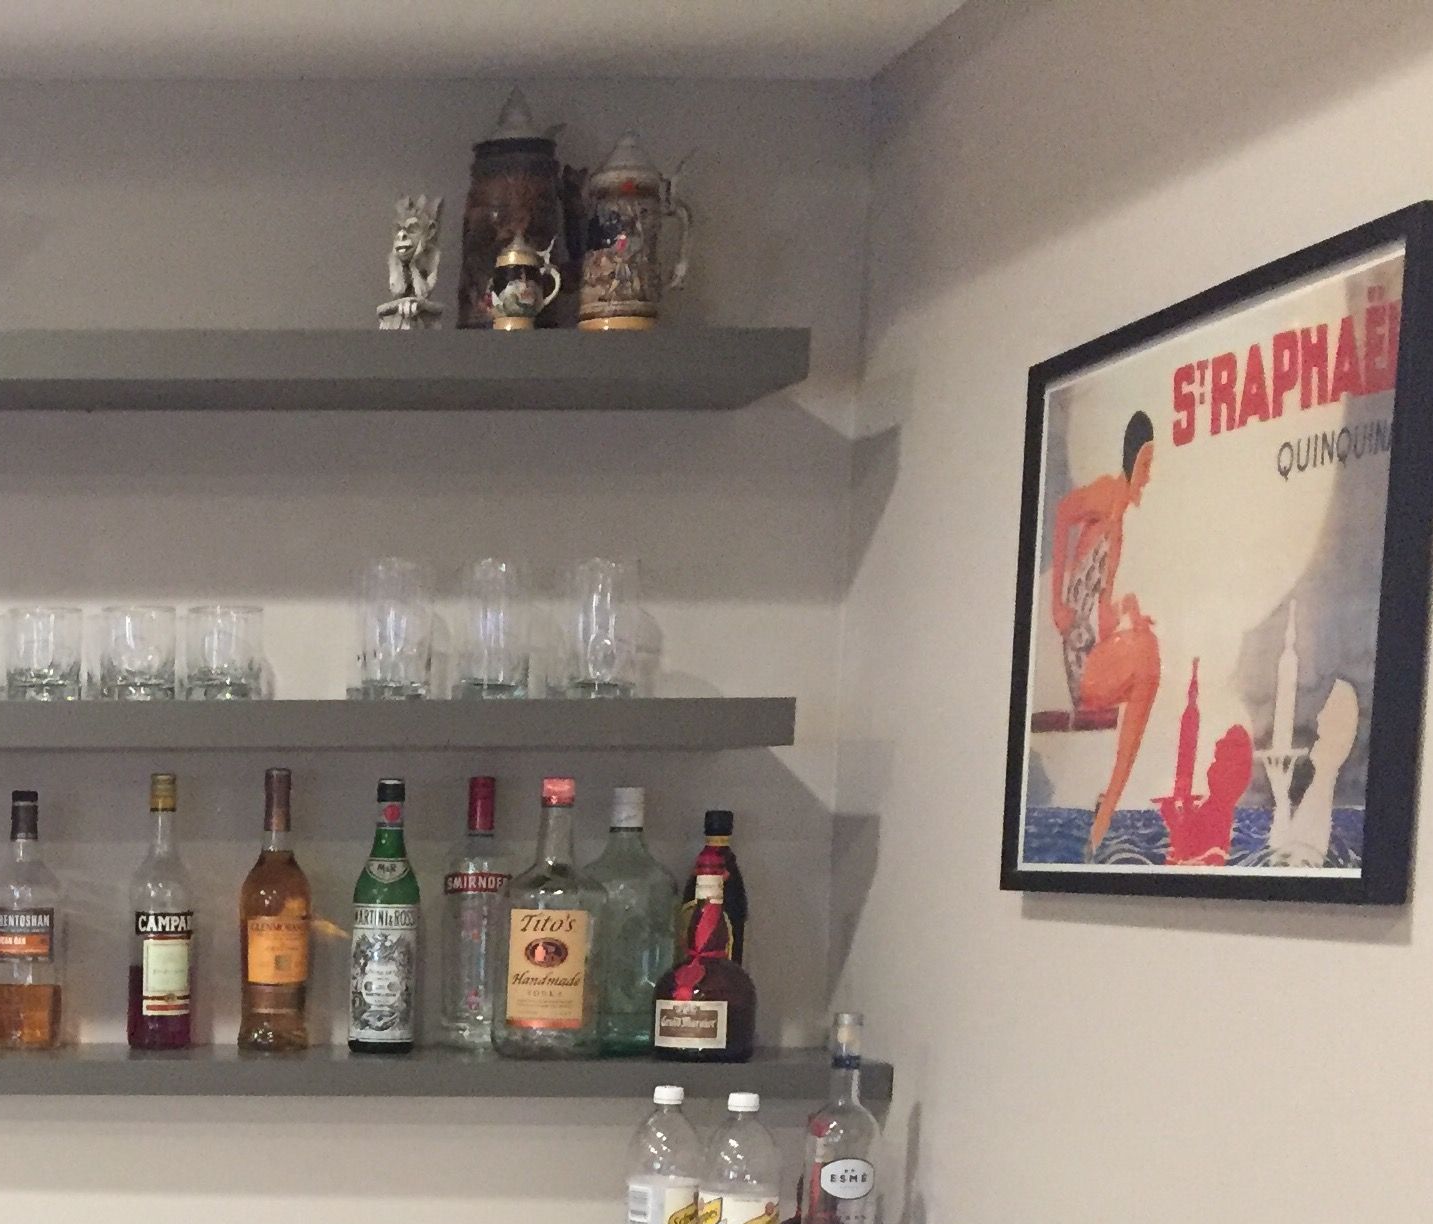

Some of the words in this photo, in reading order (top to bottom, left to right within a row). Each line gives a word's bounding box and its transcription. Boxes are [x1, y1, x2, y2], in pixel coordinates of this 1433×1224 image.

[1277, 419, 1392, 482] QUINQUIN
[138, 914, 193, 932] CAMPA
[520, 912, 576, 933] Tito's
[512, 969, 581, 987] Handmade
